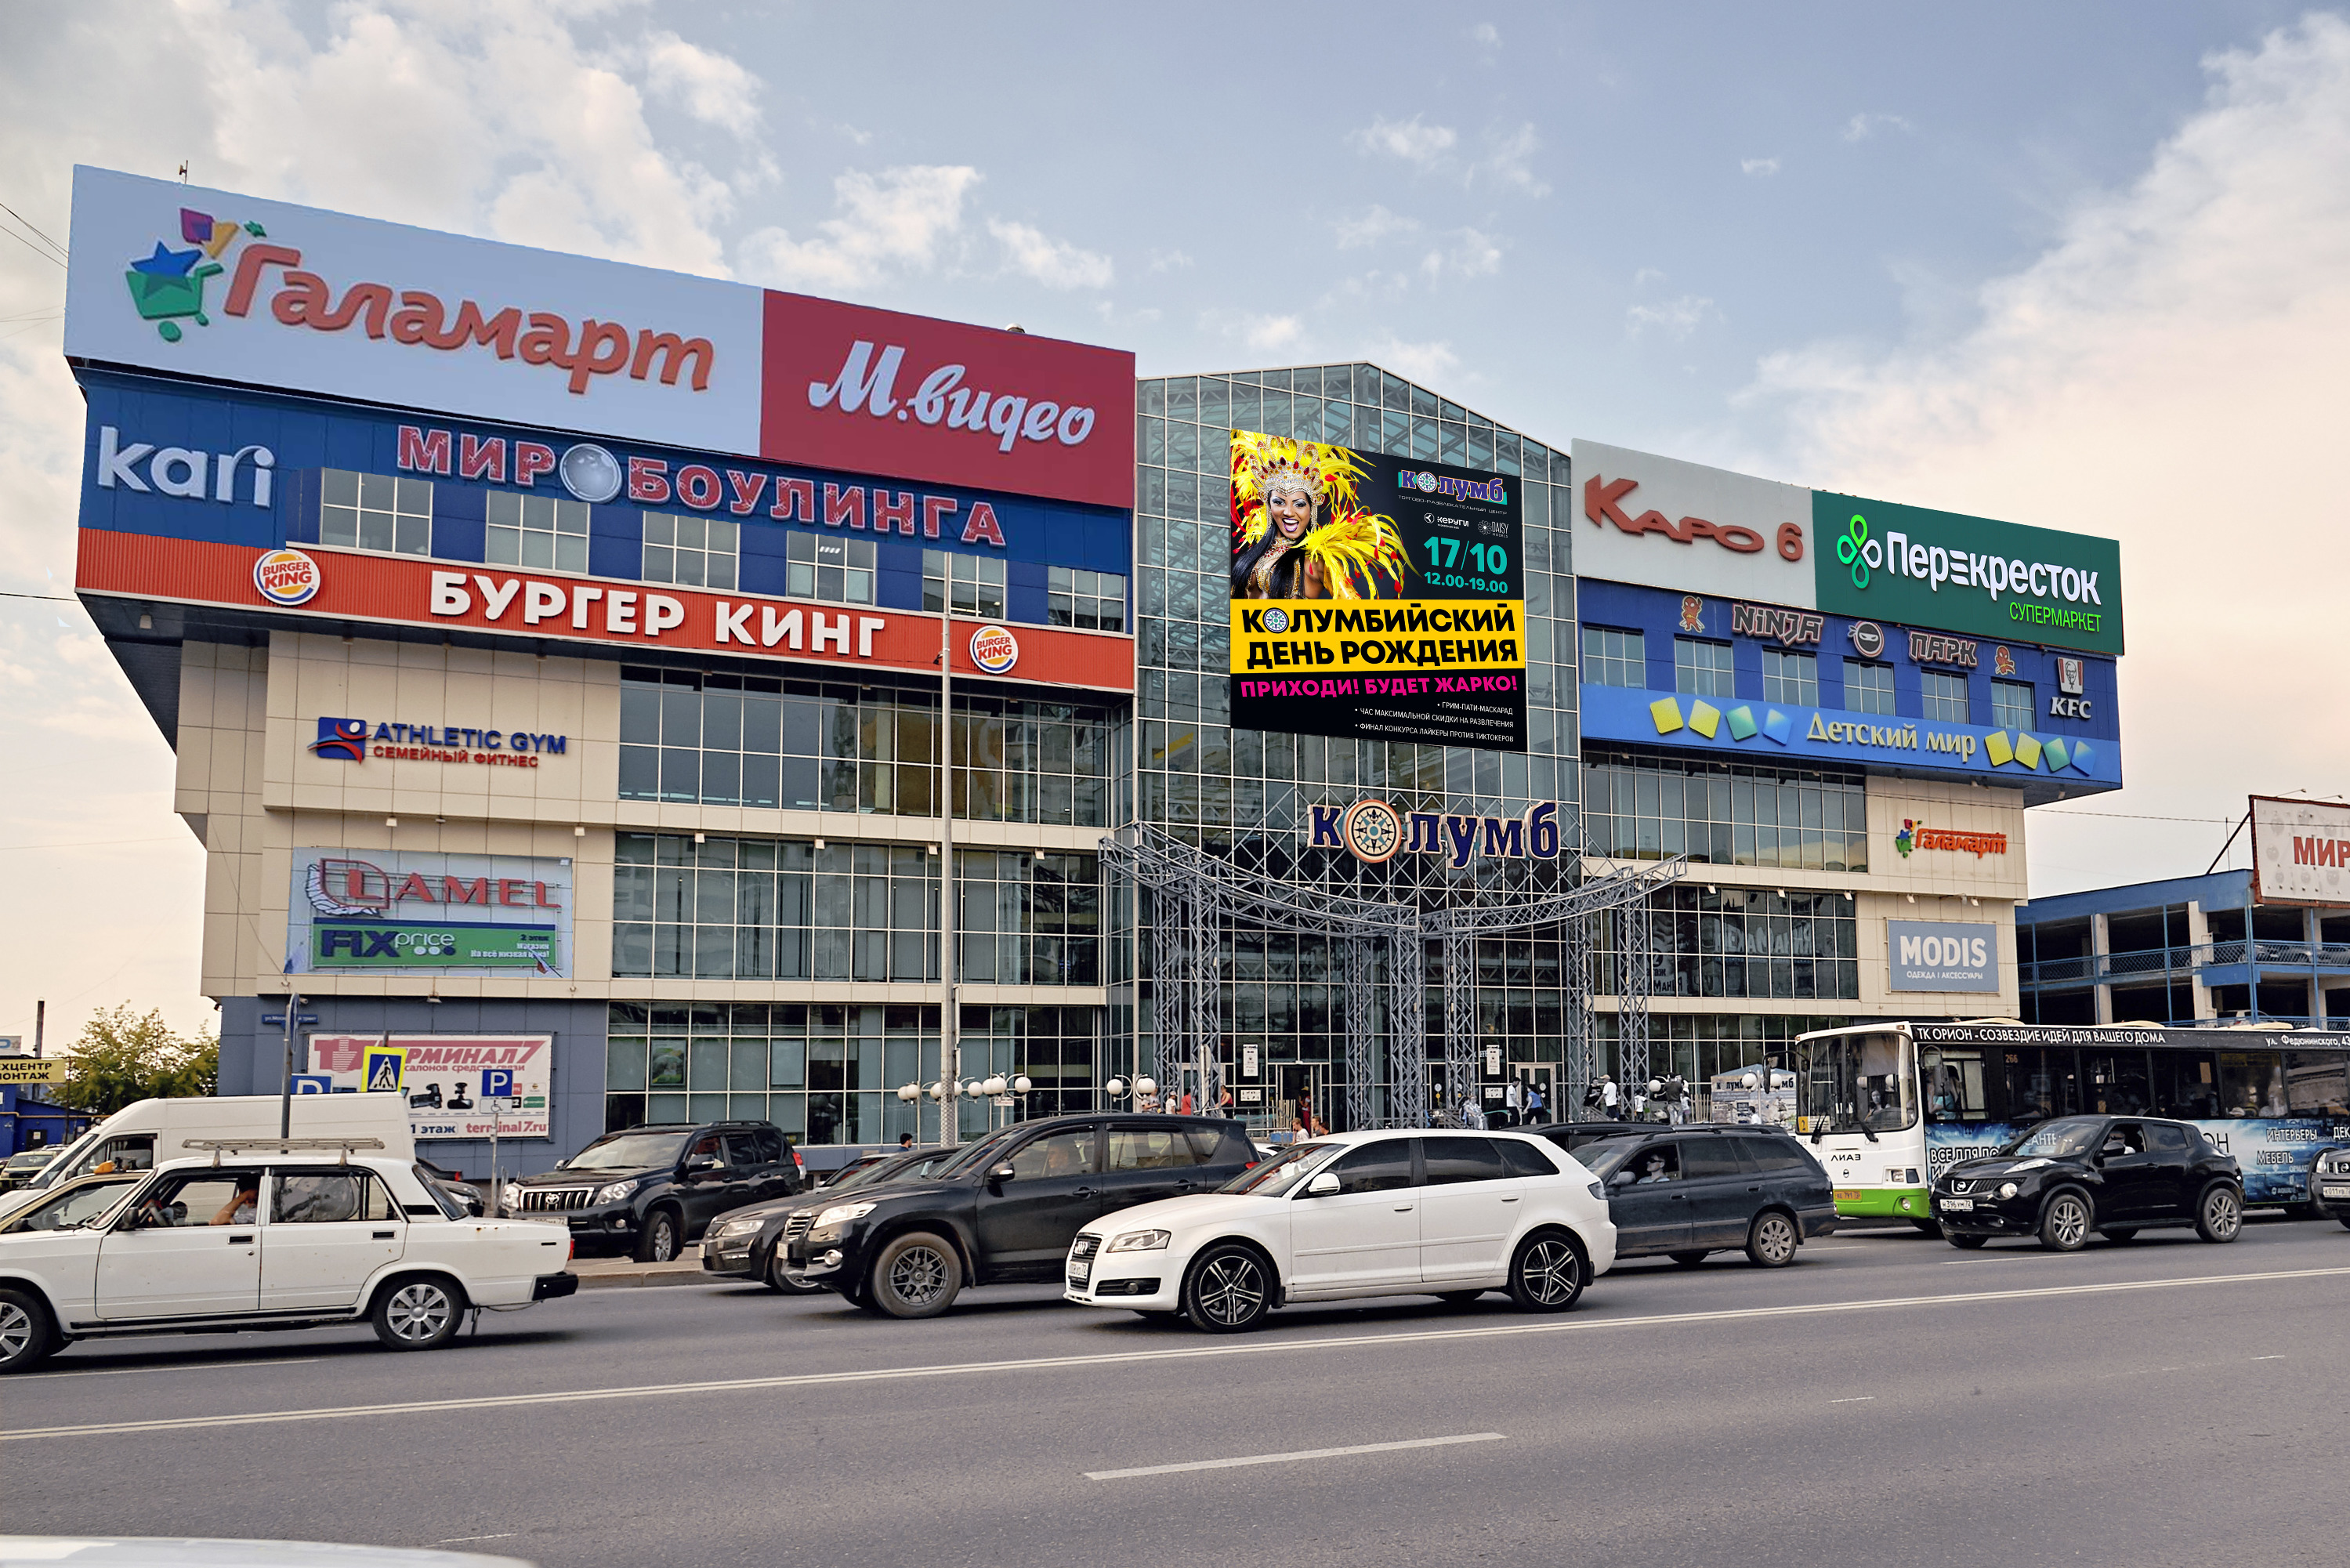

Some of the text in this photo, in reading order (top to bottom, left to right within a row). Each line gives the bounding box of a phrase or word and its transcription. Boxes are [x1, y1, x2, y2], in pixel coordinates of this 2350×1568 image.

[223, 243, 716, 396] Галамарт
[807, 340, 1096, 452] М.видео
[96, 425, 276, 509] kari
[397, 424, 1007, 548] МИР БОУЛИНГА
[1398, 494, 1486, 512] ТОРГОВО-РАЗВЛЕКАТЕЛЬНЫЙ
[1492, 521, 1509, 534] DAISY
[1776, 522, 1804, 562] 6
[1423, 536, 1508, 575] 17/10
[263, 561, 310, 577] BURGER
[264, 570, 313, 591] KING
[1424, 572, 1508, 595] 12.00-19.00
[429, 570, 885, 657] БУРГЕР КИНГ
[2008, 600, 2102, 633] СУПЕРМАРКЕТ
[976, 636, 1011, 650] BURGER
[978, 644, 1012, 661] KING
[1247, 639, 1518, 670] ДЕНЬ РОЖДЕНИЯ
[1908, 629, 1979, 668] ПАРК
[1240, 675, 1518, 697] ПРИХОДИ! БУДЕТ ЖАРКО!
[1374, 709, 1430, 720] МАКСИМАЛЬНОЙ
[1432, 714, 1458, 723] СКИДКИ
[1470, 718, 1513, 728] РАЗВЛЕЧЕНИЯ
[1442, 702, 1513, 715] ГРИМ-ПАТИ-МАСКАРАД
[2050, 696, 2091, 719] KFC
[372, 721, 567, 755] ATHLETIC GYM
[1360, 722, 1513, 742] ФИНАЛ КОНКУРСА ЛАЙКЕРЫ ПРОТИВ ТИКТОКЕРОВ
[1806, 711, 1977, 763] Детский мир
[372, 744, 539, 768] СЕМЕЙНЫЙ ФИТНЕС
[1915, 828, 2008, 859] Галамарт
[2293, 835, 2350, 868] МИР
[347, 867, 563, 909] LAMEL
[320, 930, 456, 958] FIX price
[1899, 935, 1987, 968] MODIS
[1906, 971, 1935, 980] ОДЕЖДА
[1917, 1027, 1931, 1040] ТК
[1932, 1027, 1972, 1041] ОРИОН
[1979, 1028, 2040, 1043] СОЗВЕЗДИЕ
[2041, 1029, 2070, 1044] ИДЕЙ
[2072, 1031, 2092, 1044] ДЛЯ
[2094, 1030, 2135, 1045] ВАШЕГО
[2135, 1031, 2166, 1045] ДОМА
[0, 1063, 53, 1072] ХЦЕНТР
[411, 1124, 456, 1134] 1 этаж
[2266, 1128, 2318, 1143] ИНТЕРЬЕРЫ
[1931, 1148, 1952, 1163] ВСЕ
